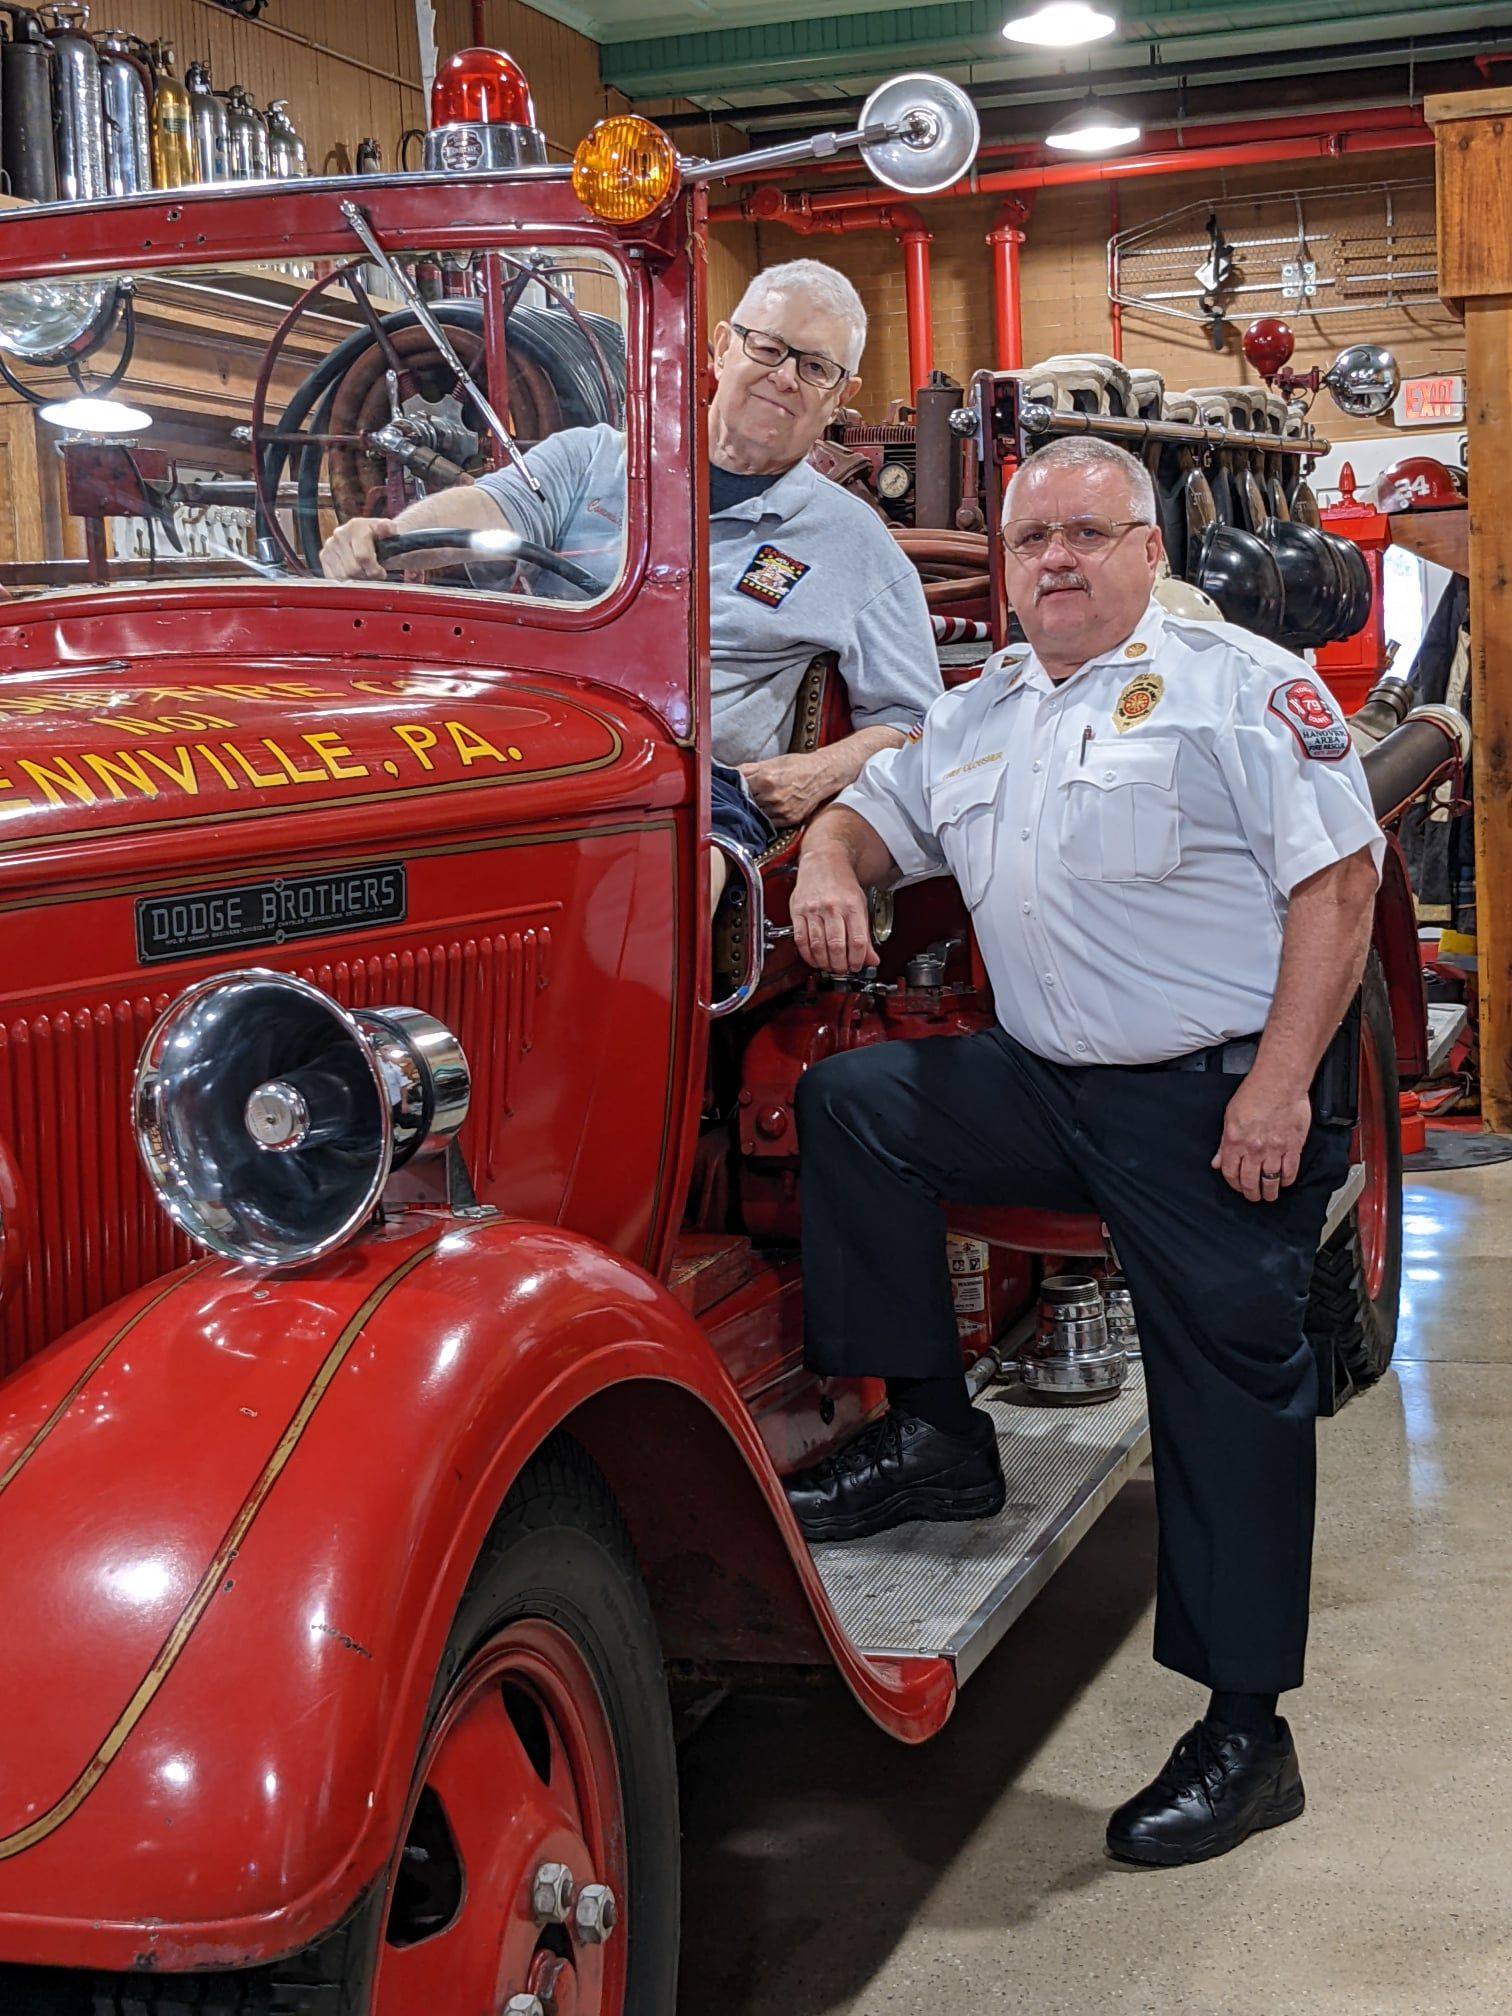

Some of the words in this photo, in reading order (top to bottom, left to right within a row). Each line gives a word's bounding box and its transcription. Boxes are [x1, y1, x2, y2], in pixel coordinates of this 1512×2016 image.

[1405, 379, 1453, 418] EXIT
[147, 682, 348, 703] FIRE
[1301, 699, 1322, 711] 79
[391, 720, 523, 770] PA.
[1315, 736, 1341, 745] AREA
[151, 897, 242, 941] DODGE
[261, 875, 395, 924] BROTHERS
